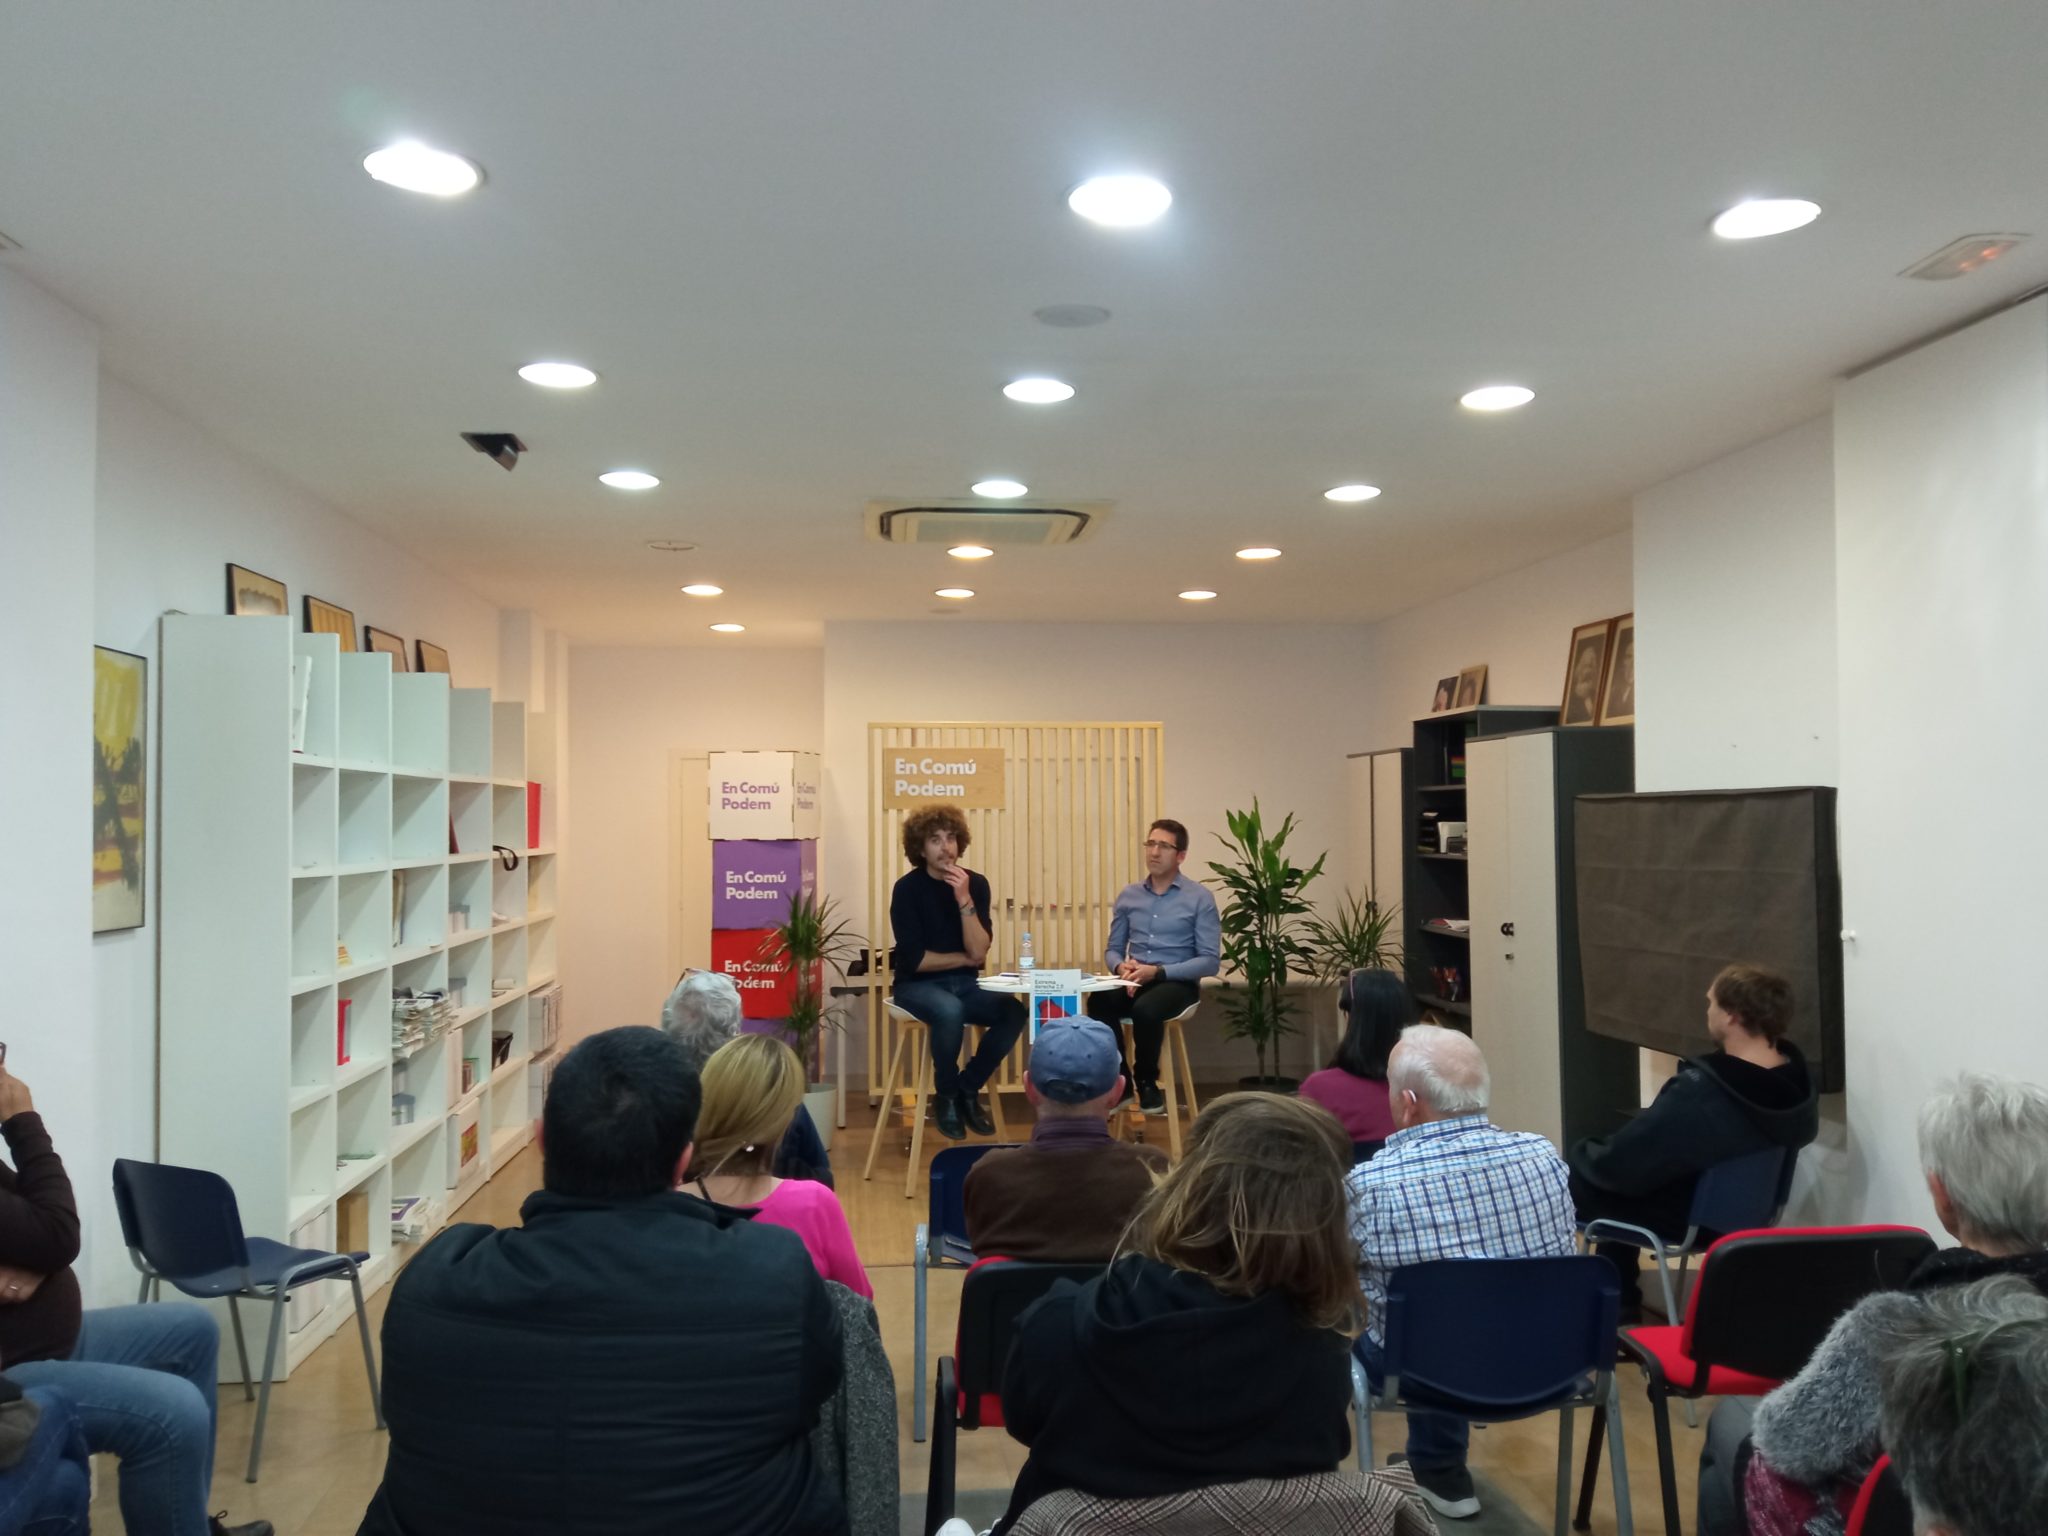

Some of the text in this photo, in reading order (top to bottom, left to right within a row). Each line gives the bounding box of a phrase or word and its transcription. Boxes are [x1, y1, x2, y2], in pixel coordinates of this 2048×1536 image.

[895, 758, 976, 775] En Comú
[722, 782, 780, 794] En Comú
[895, 780, 965, 796] Podem
[722, 797, 771, 810] Podem
[726, 871, 786, 883] En Comú
[726, 887, 778, 899] Podem
[725, 960, 741, 972] En
[736, 976, 775, 988] odem
